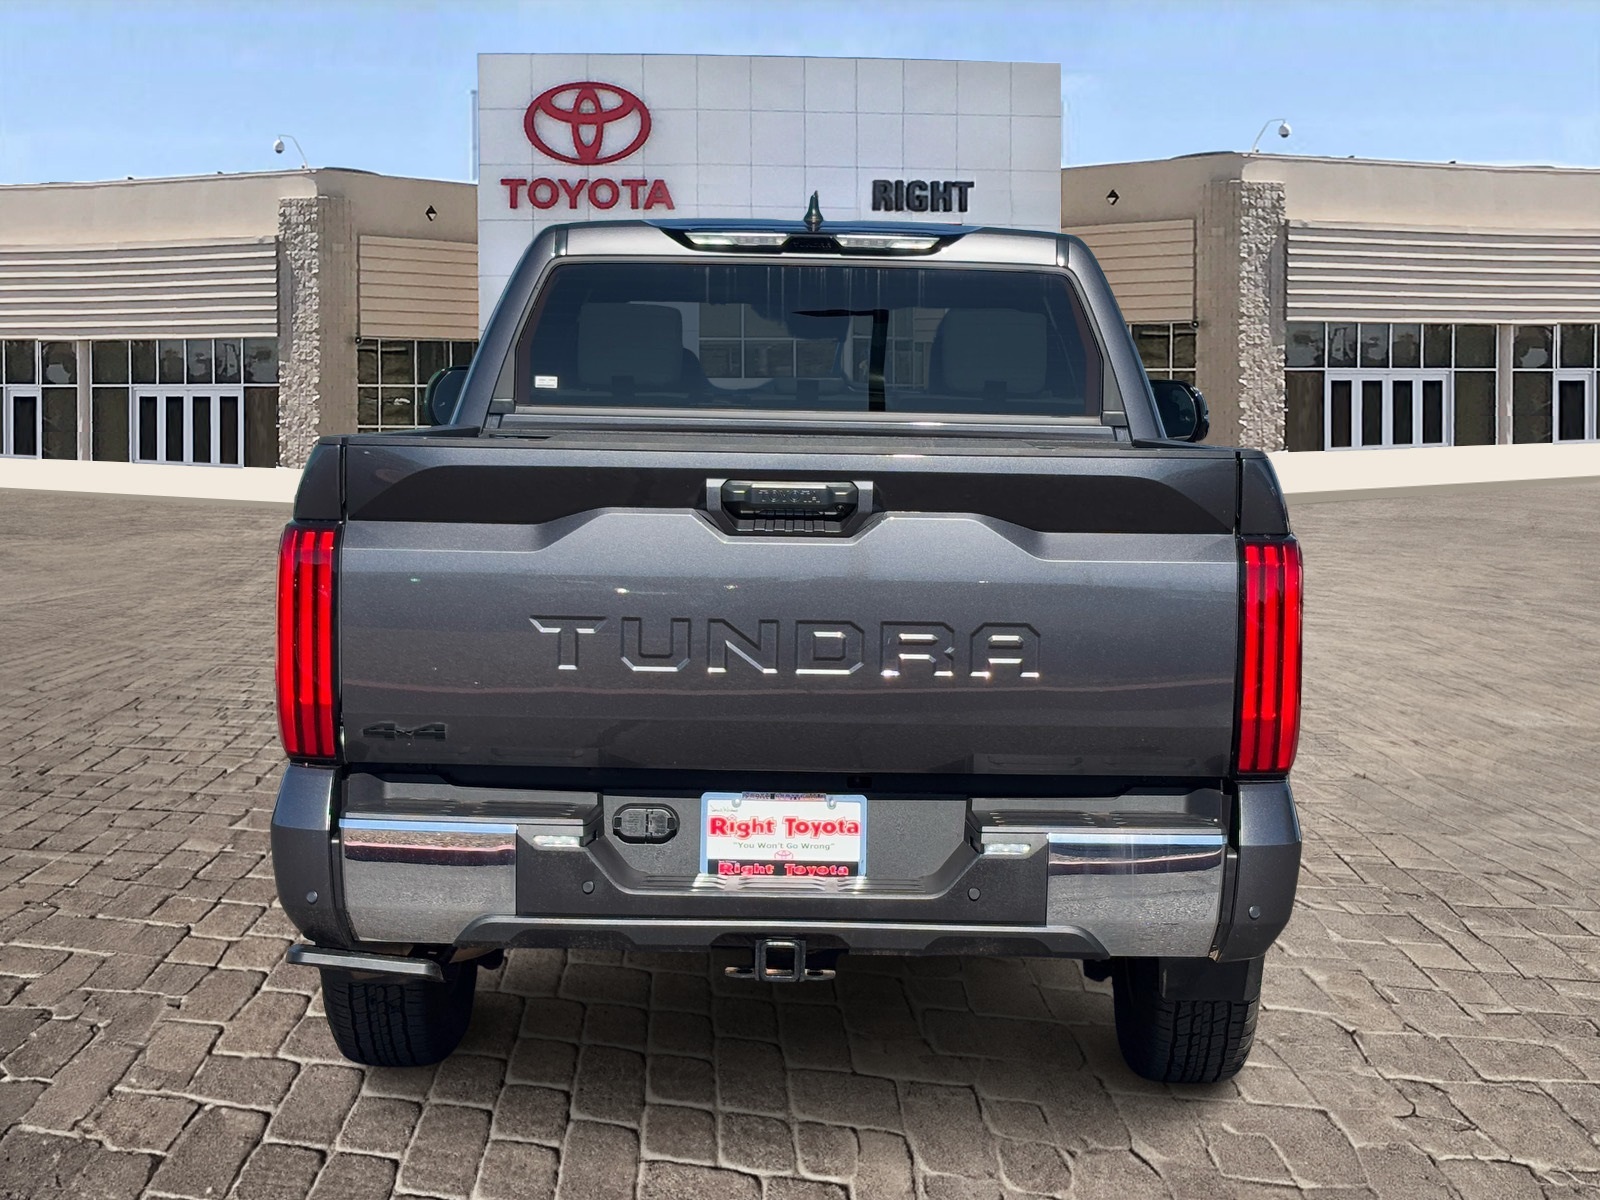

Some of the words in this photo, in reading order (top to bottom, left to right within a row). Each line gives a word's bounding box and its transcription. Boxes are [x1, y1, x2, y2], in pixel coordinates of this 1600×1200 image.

[501, 179, 675, 210] TOYOTA
[871, 179, 975, 213] RIGHT
[529, 615, 1041, 679] TUNDRA
[709, 815, 776, 839] Right
[783, 816, 860, 839] Toyota
[718, 862, 775, 876] Right
[784, 864, 849, 876] Toyota
